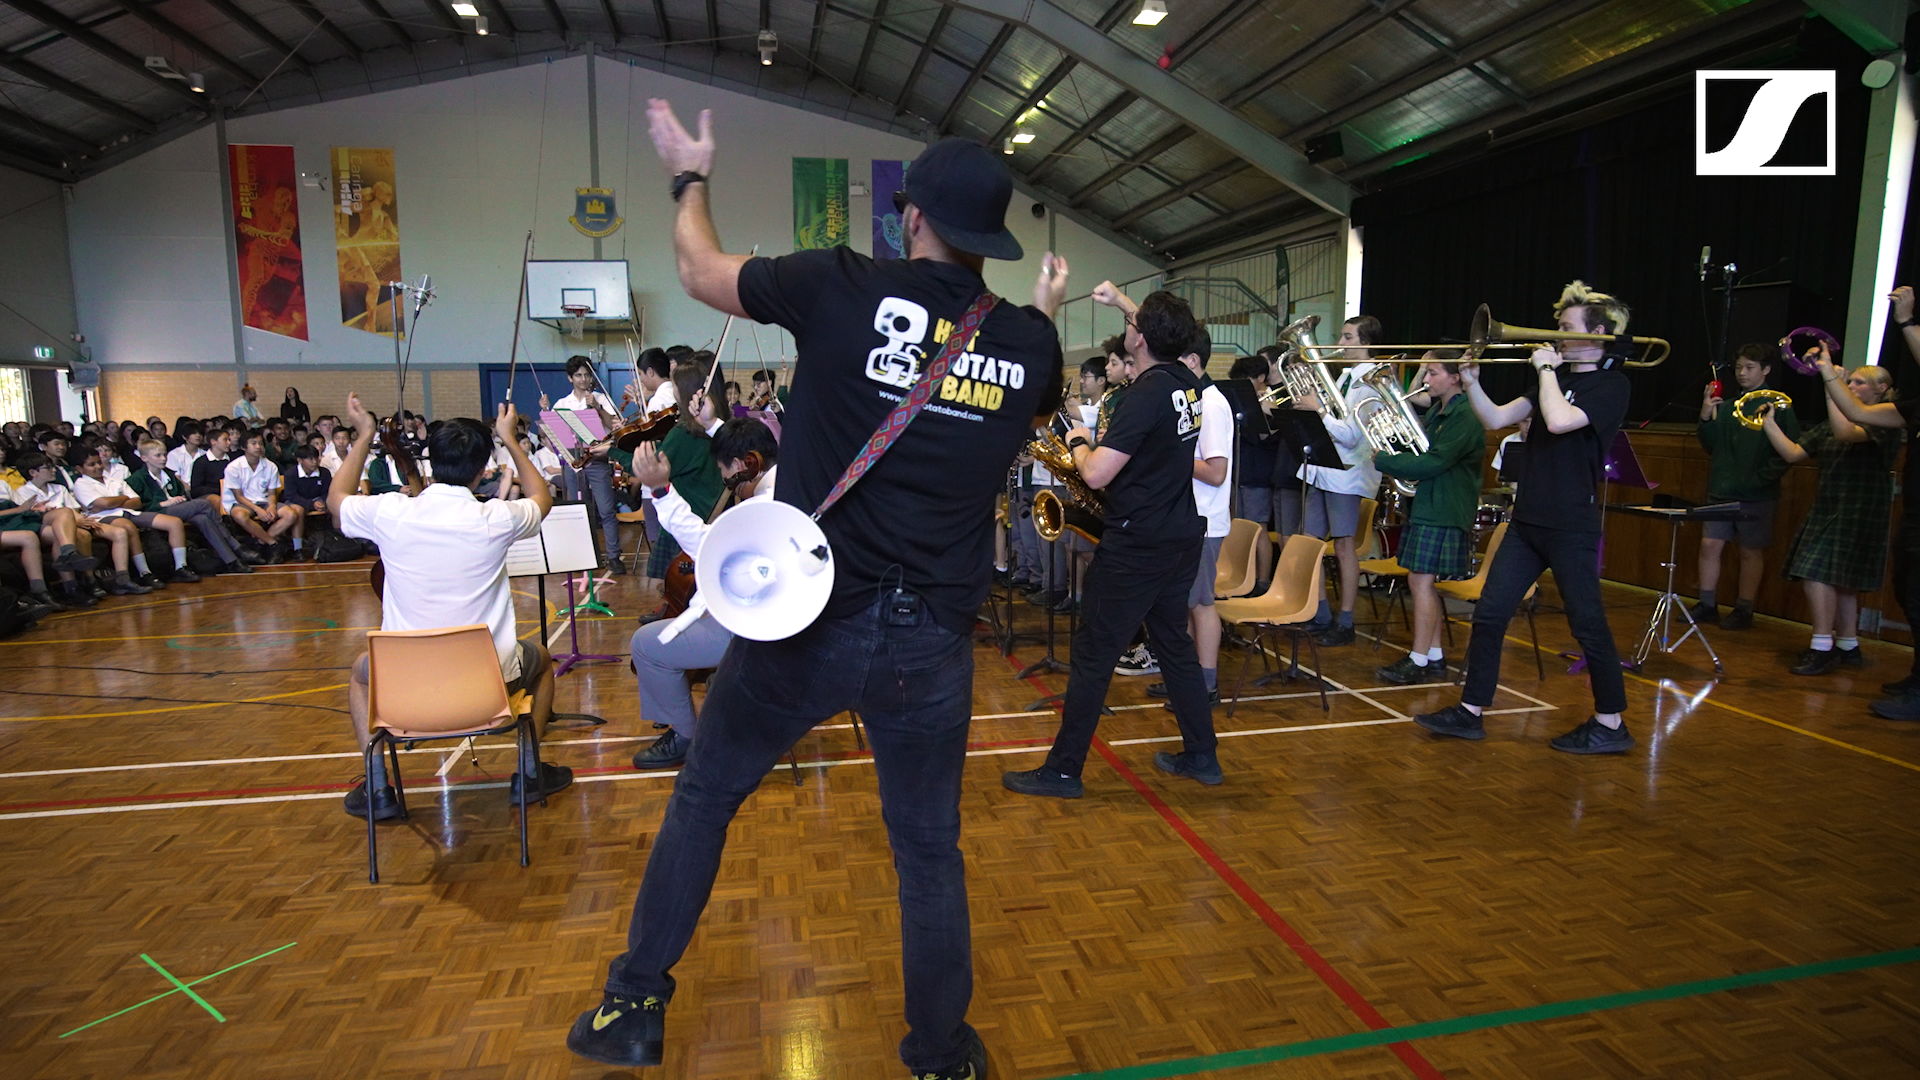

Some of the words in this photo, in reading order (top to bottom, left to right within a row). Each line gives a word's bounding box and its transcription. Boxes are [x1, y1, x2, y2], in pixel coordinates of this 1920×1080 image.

[350, 155, 363, 211] Caringa
[933, 318, 980, 352] HT
[952, 352, 1025, 390] OTATO
[940, 375, 1004, 411] BAND
